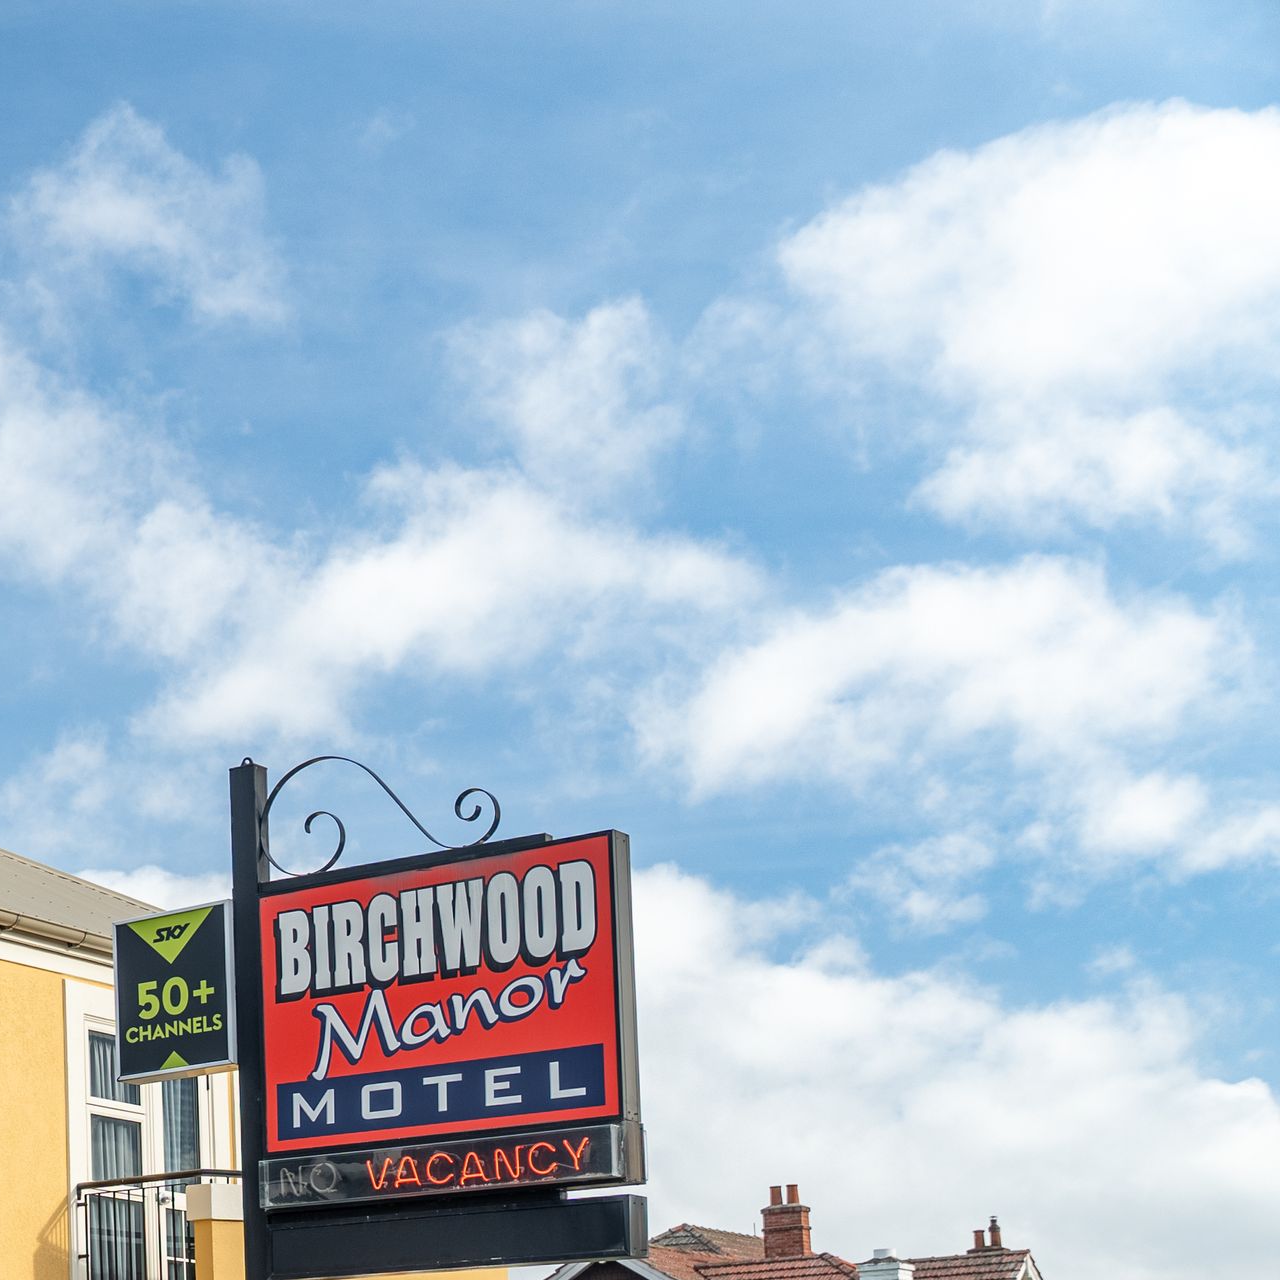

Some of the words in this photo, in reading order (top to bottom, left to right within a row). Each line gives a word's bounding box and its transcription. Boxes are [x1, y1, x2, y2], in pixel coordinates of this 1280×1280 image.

[152, 922, 192, 944] SKY
[275, 859, 598, 1001] BIRCHWOOD
[125, 1013, 223, 1044] CHANNELS
[137, 976, 215, 1020] 50+
[312, 958, 586, 1082] Manor
[292, 1060, 587, 1129] MOTEL
[278, 1161, 342, 1198] NO
[365, 1136, 590, 1191] VACANCY
